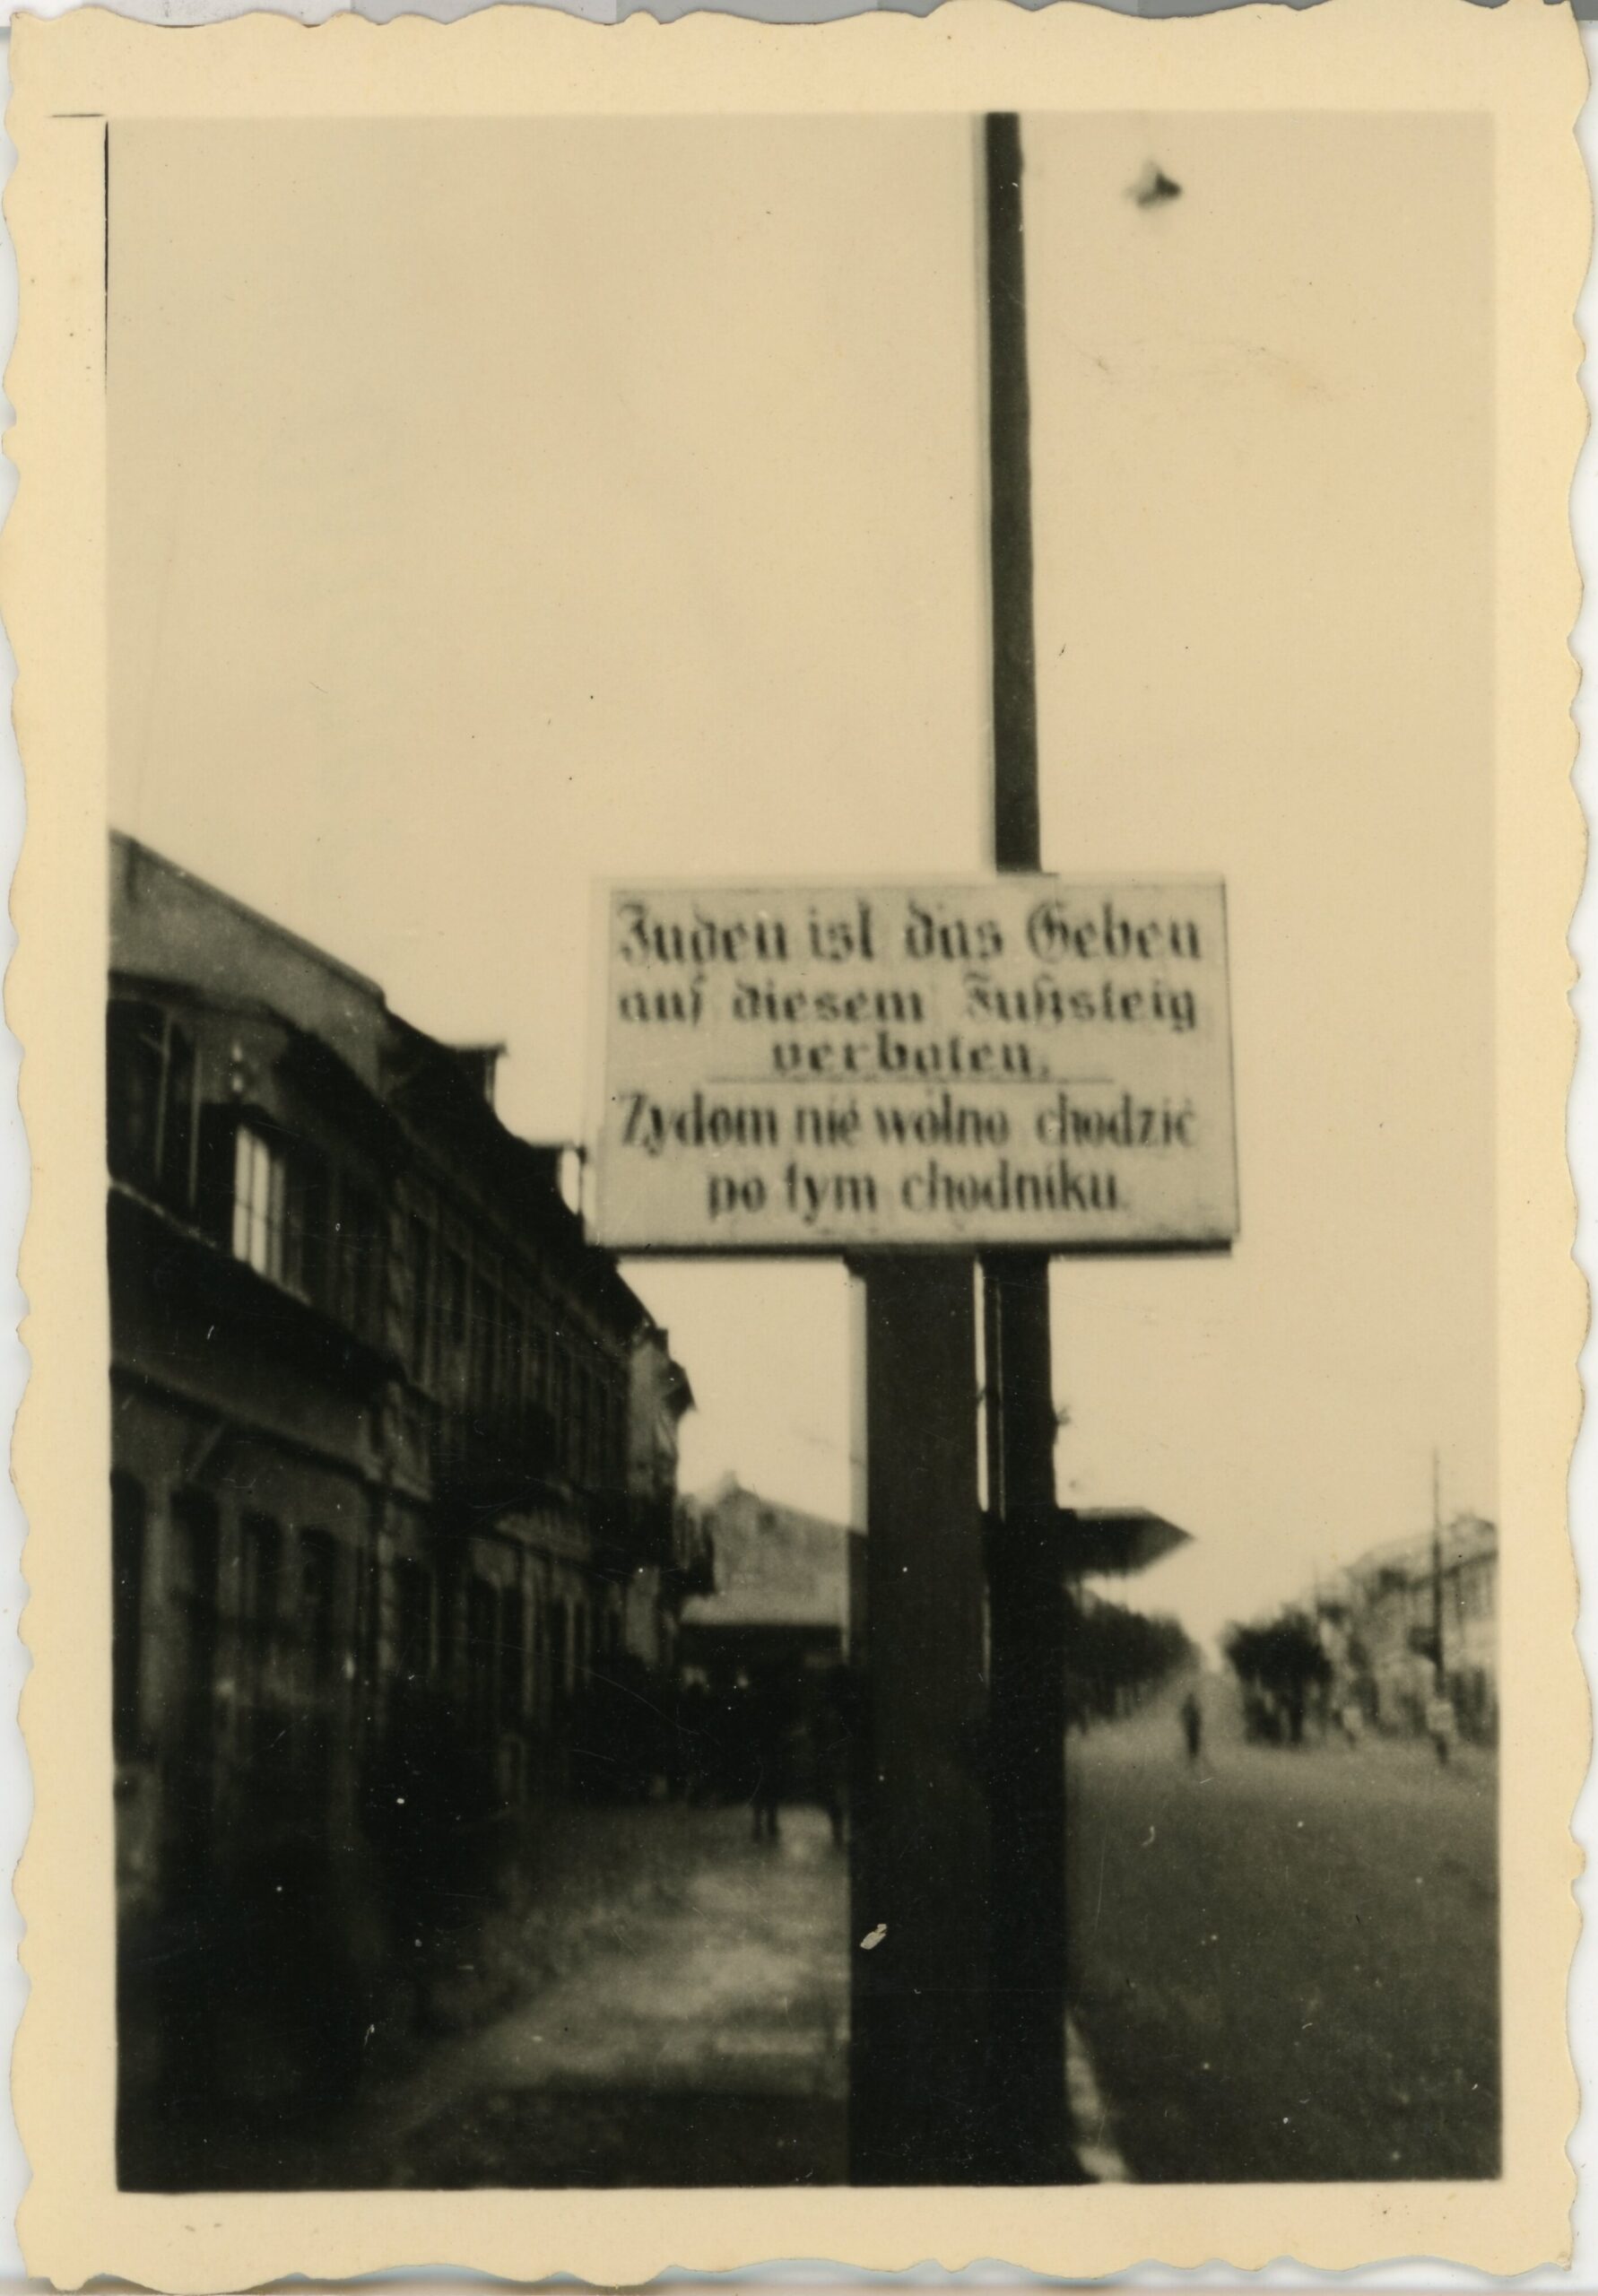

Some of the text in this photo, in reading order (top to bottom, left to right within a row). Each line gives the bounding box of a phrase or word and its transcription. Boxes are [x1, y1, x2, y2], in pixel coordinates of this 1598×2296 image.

[619, 901, 788, 968] Juden
[809, 902, 874, 963] ist
[904, 901, 1003, 962] das
[619, 976, 703, 1025] auf
[733, 979, 925, 1023] diesem
[1035, 1094, 1196, 1147] chodzić
[707, 1174, 765, 1220] po
[787, 1161, 876, 1224] tym
